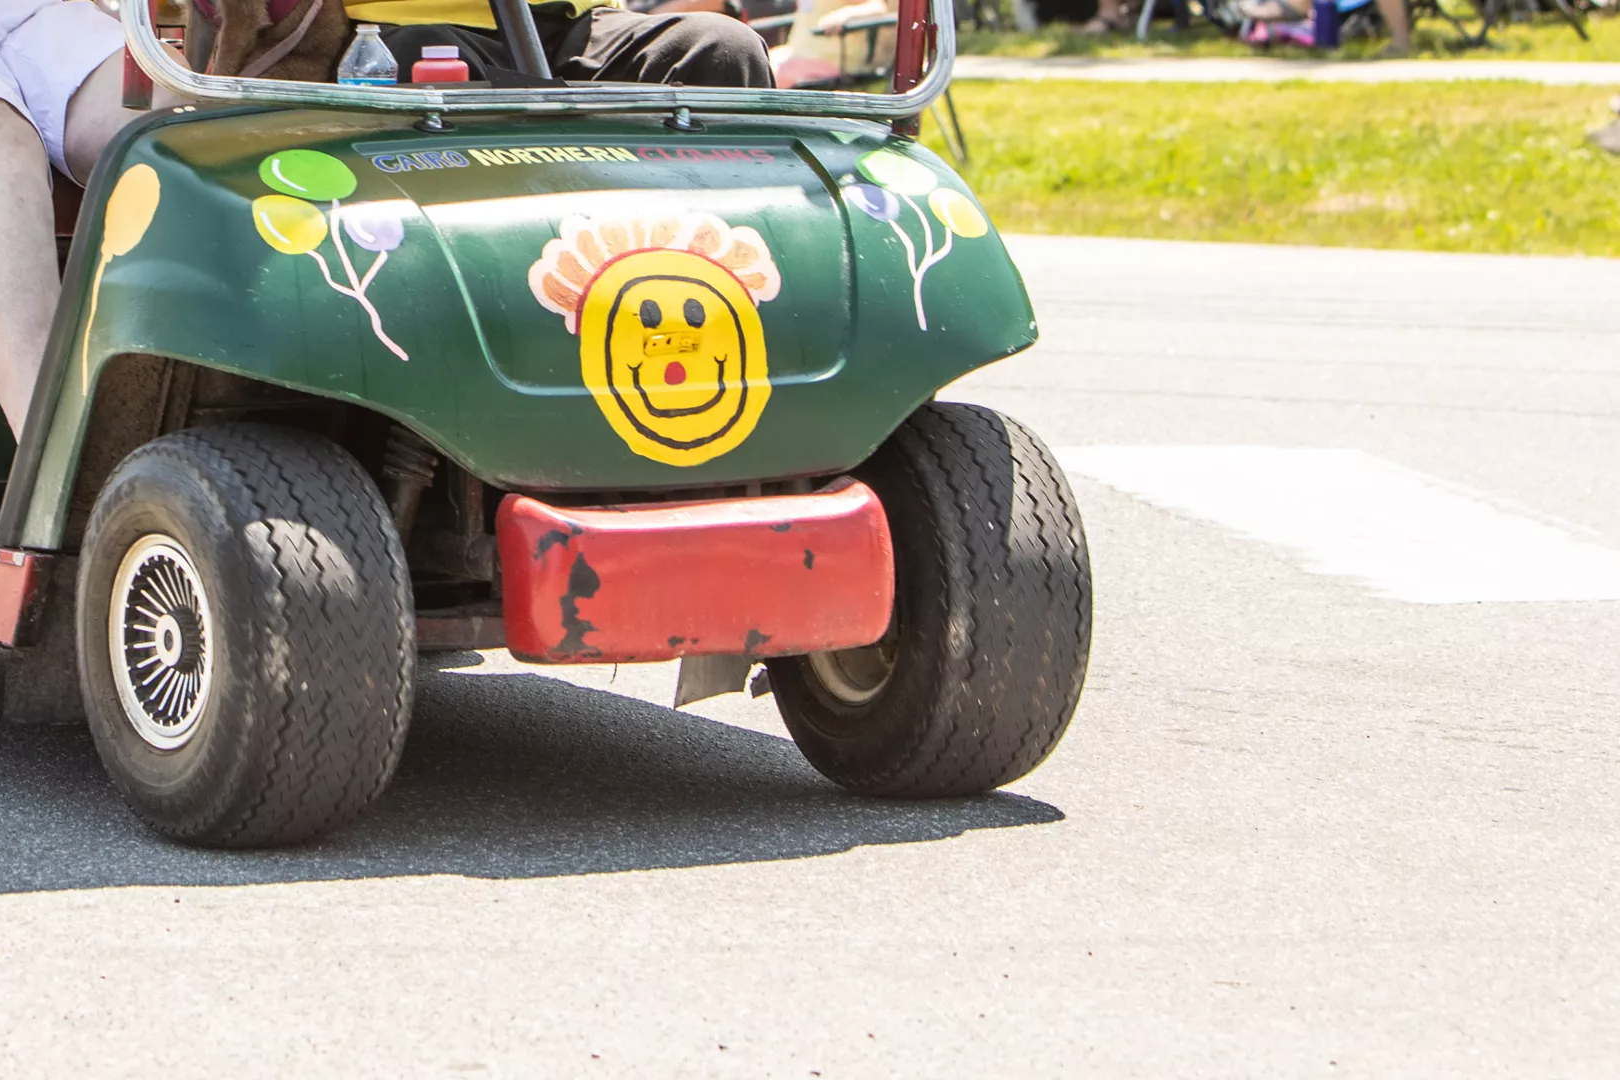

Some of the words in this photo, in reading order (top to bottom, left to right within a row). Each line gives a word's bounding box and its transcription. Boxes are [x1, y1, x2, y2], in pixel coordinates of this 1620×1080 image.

[372, 150, 470, 173] CAIRO
[468, 146, 640, 167] NORTHERN
[637, 147, 775, 164] CLOWNS
